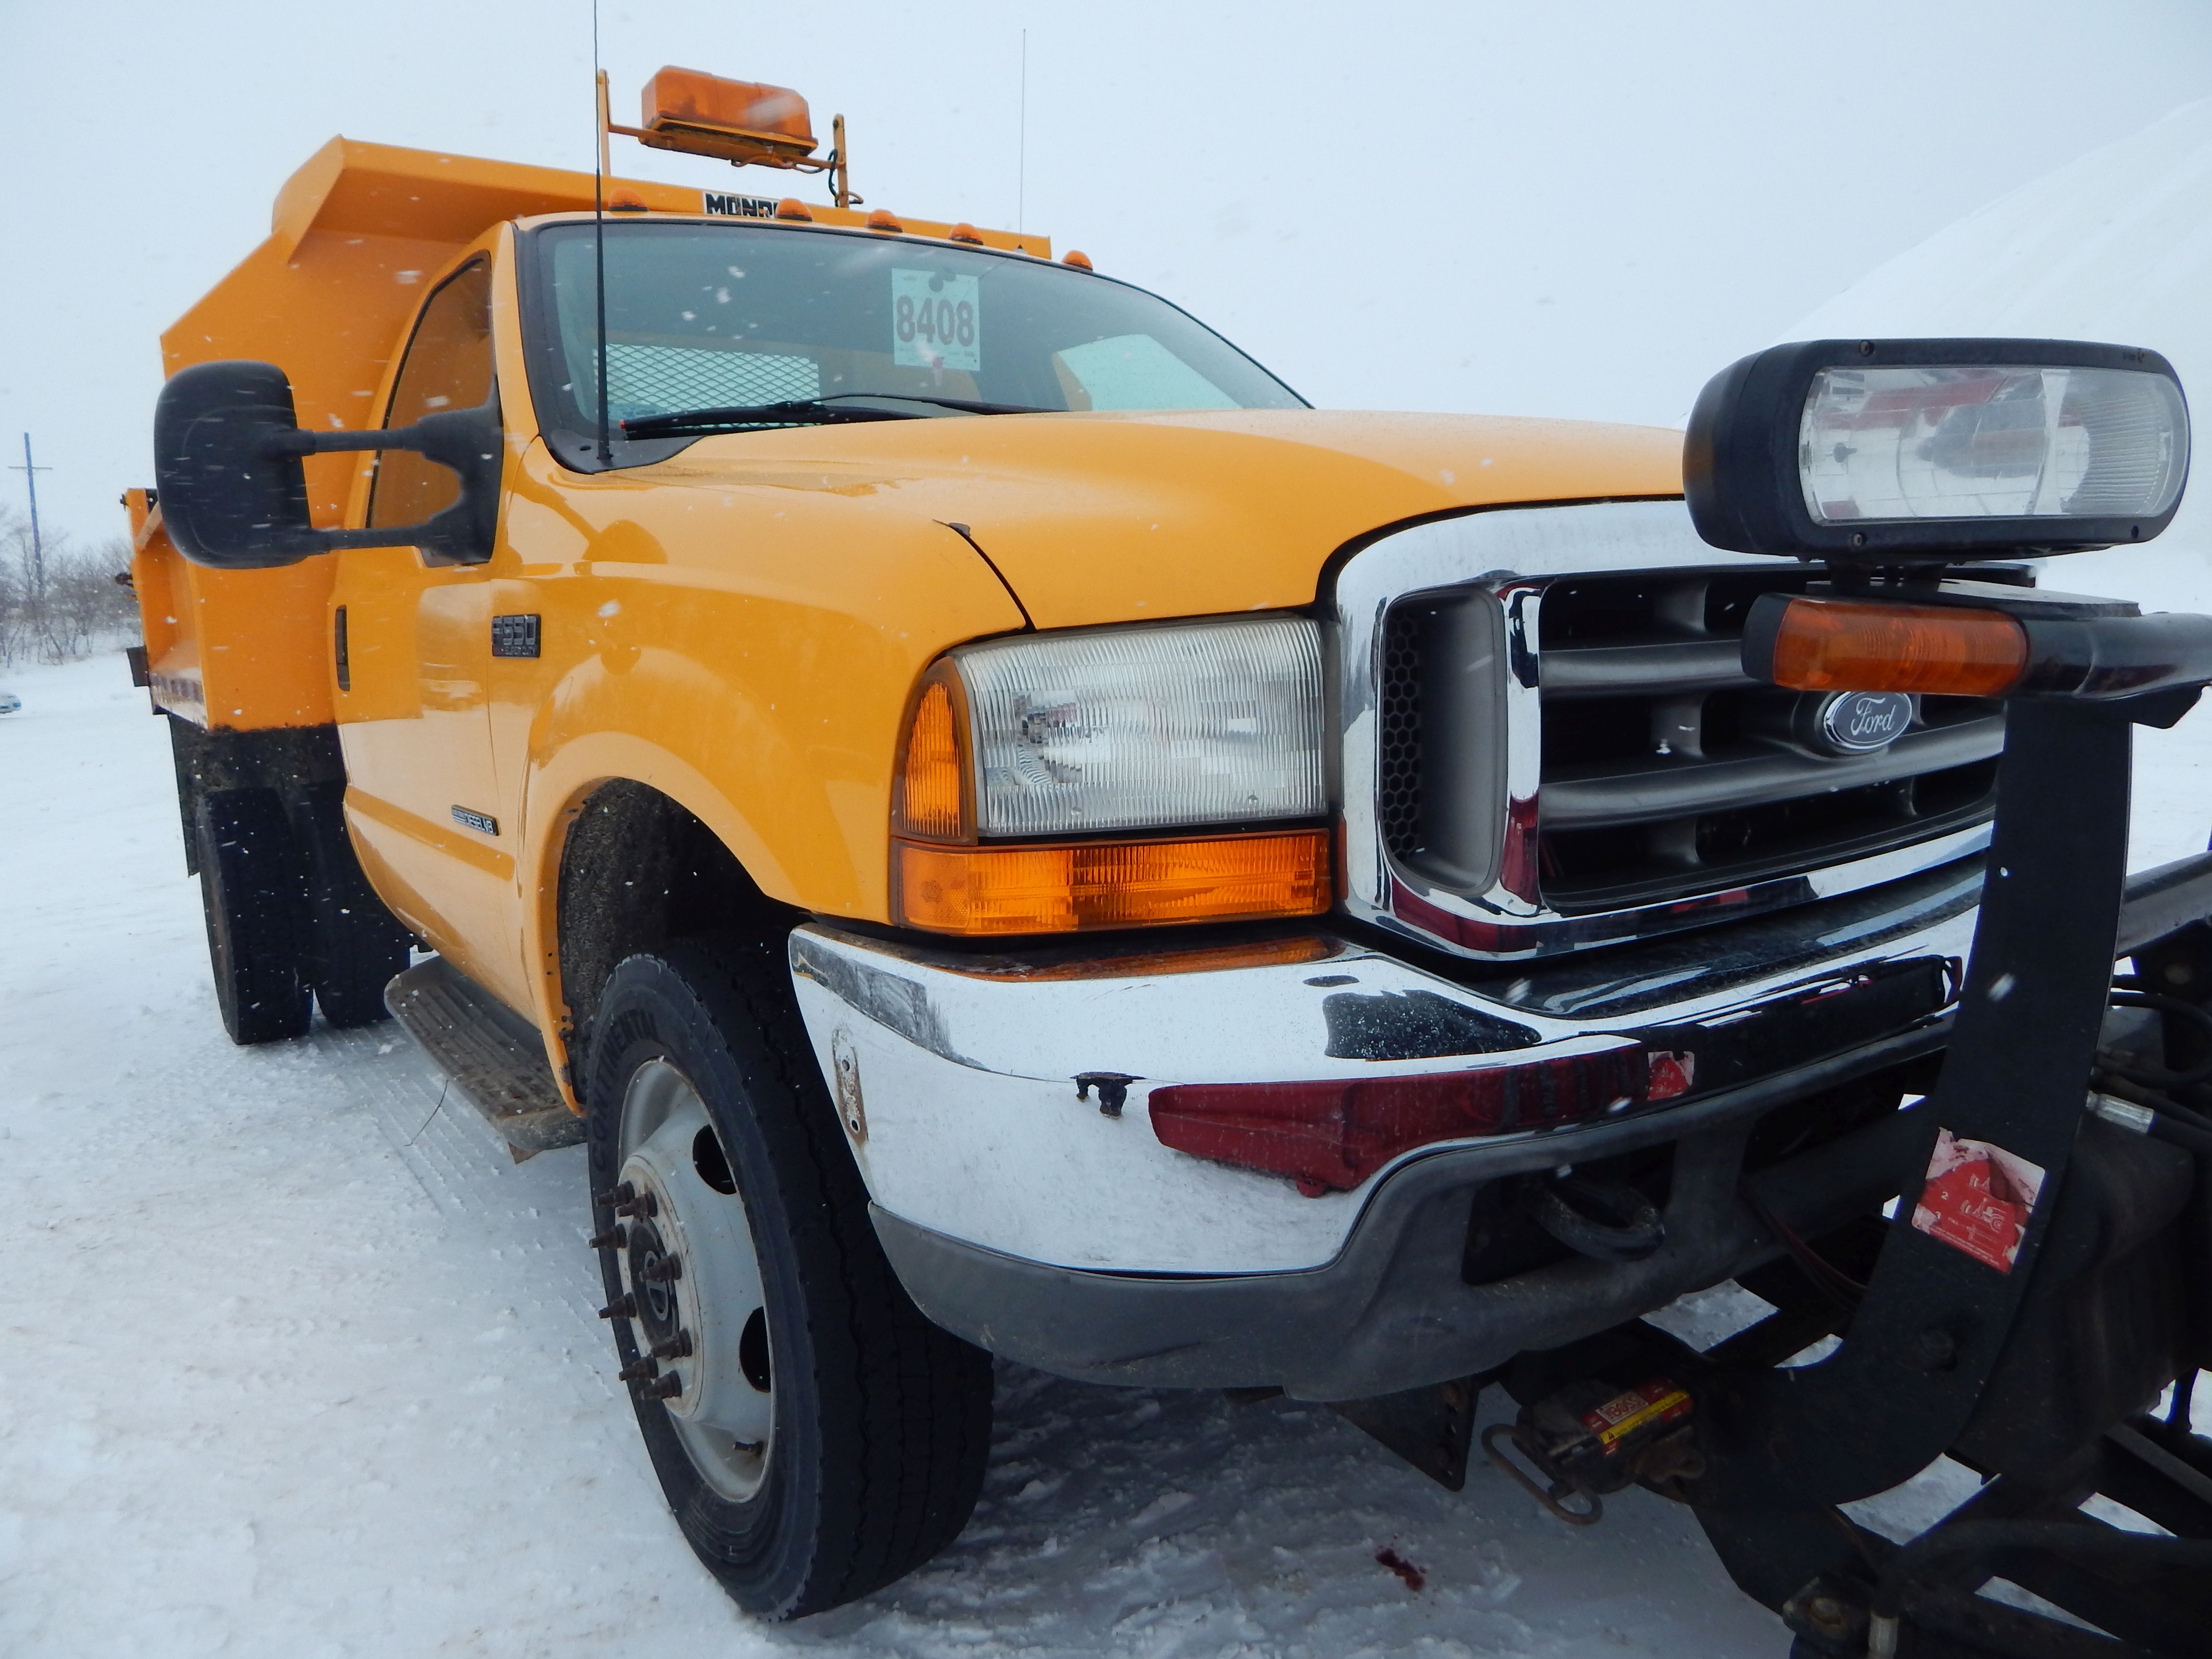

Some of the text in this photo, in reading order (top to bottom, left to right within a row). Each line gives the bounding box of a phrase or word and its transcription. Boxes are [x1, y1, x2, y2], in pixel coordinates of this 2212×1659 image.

[706, 193, 778, 217] MONR
[896, 294, 975, 347] 8408
[1850, 697, 1897, 736] Ford
[591, 1008, 660, 1172] CONTINENTAL
[1941, 1191, 1949, 1200] 2
[1610, 1395, 1640, 1417] BOSS
